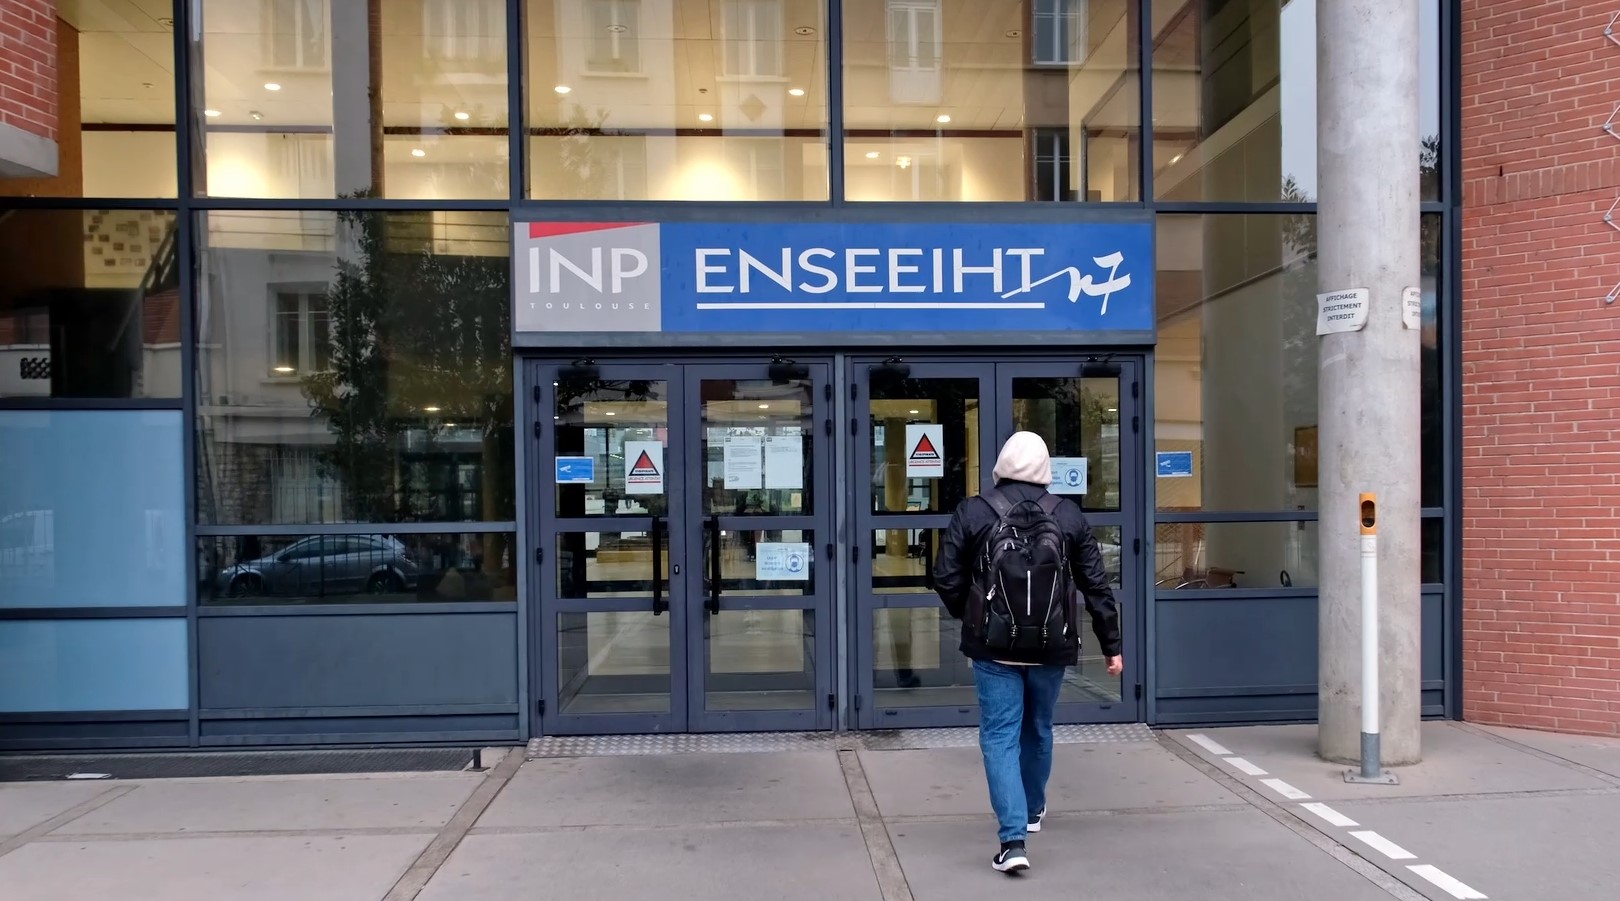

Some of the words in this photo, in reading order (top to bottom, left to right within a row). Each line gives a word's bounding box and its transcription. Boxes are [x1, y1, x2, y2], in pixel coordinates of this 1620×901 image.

[529, 247, 649, 294] INP
[695, 247, 1045, 294] ENSEEIHT
[1326, 292, 1358, 302] AFFICHAGE
[529, 302, 650, 310] TOULOUSE
[1323, 302, 1362, 313] STRICTEMENT
[1327, 313, 1355, 321] INTERDIT
